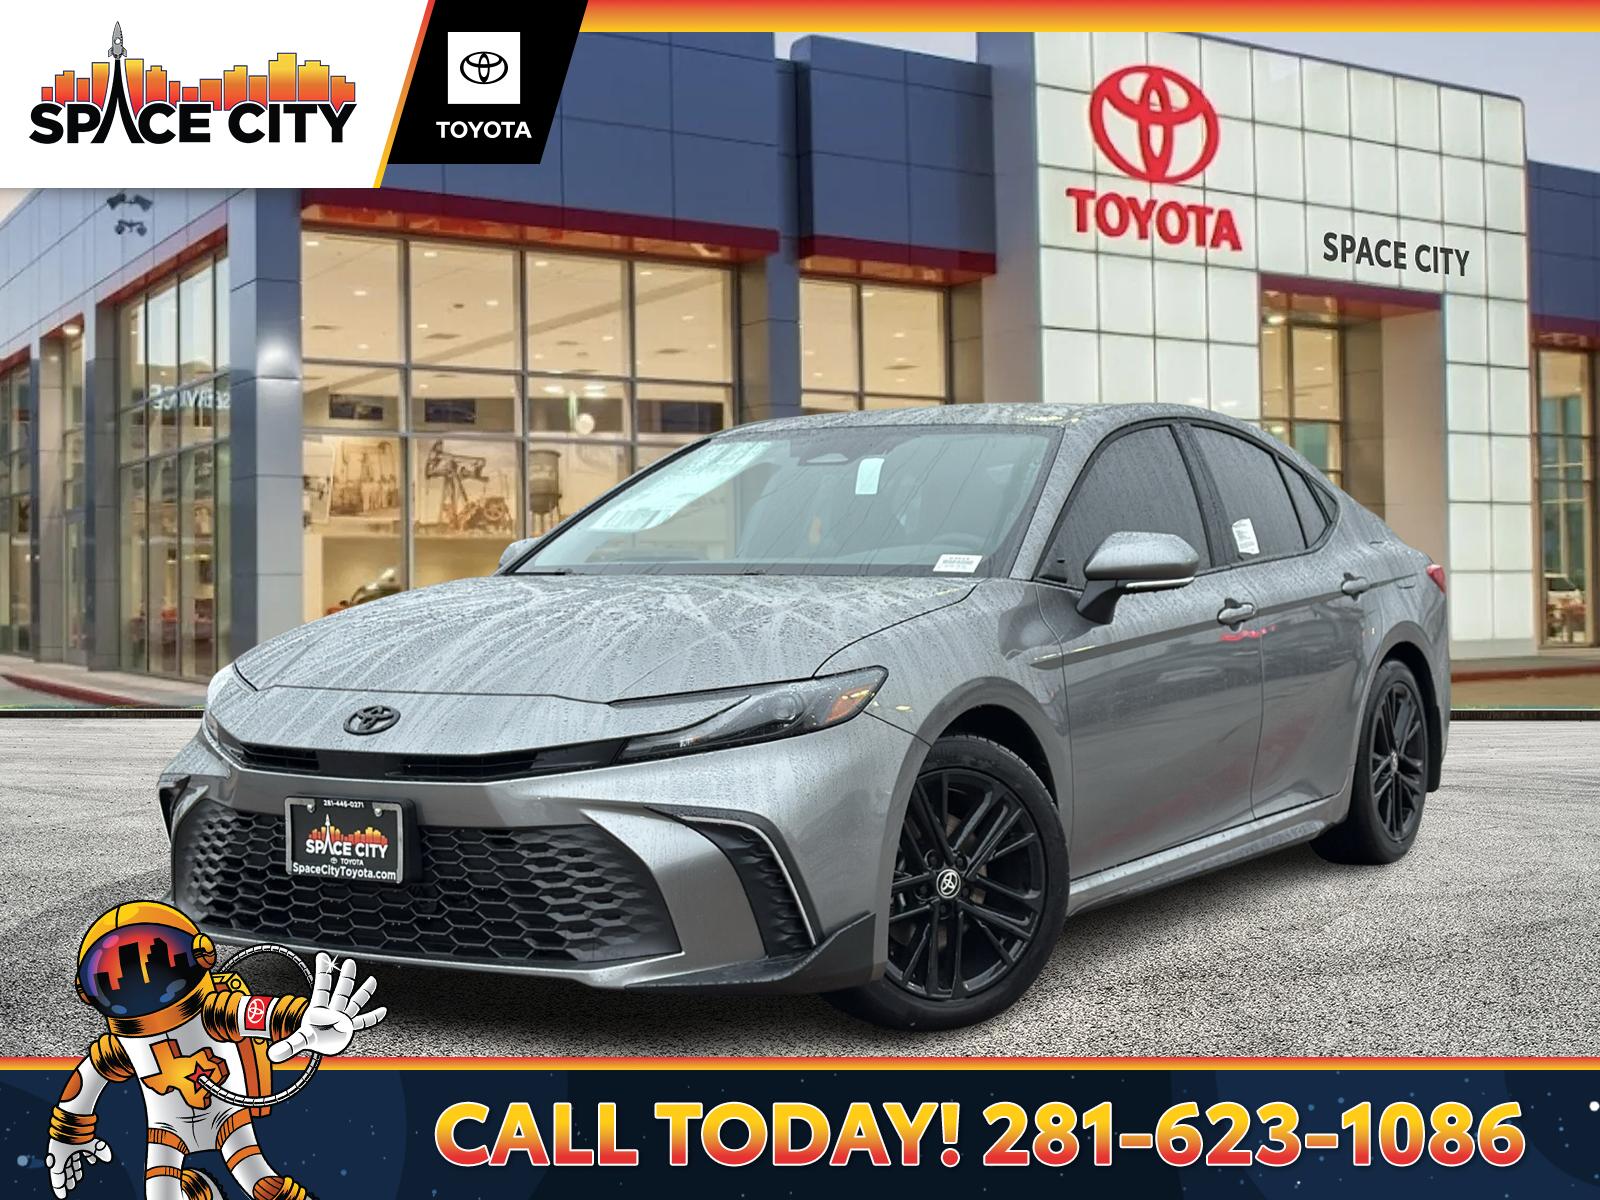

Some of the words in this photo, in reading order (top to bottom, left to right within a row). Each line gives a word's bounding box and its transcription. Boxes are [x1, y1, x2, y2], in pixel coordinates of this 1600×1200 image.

[1065, 187, 1243, 251] TOYOTA
[1323, 231, 1407, 270] SPACE
[1414, 243, 1470, 277] CITY
[305, 831, 352, 856] SPACE
[355, 843, 388, 859] CITY
[293, 862, 396, 880] SpaceCityToyota.com
[340, 857, 364, 866] TOYOTA
